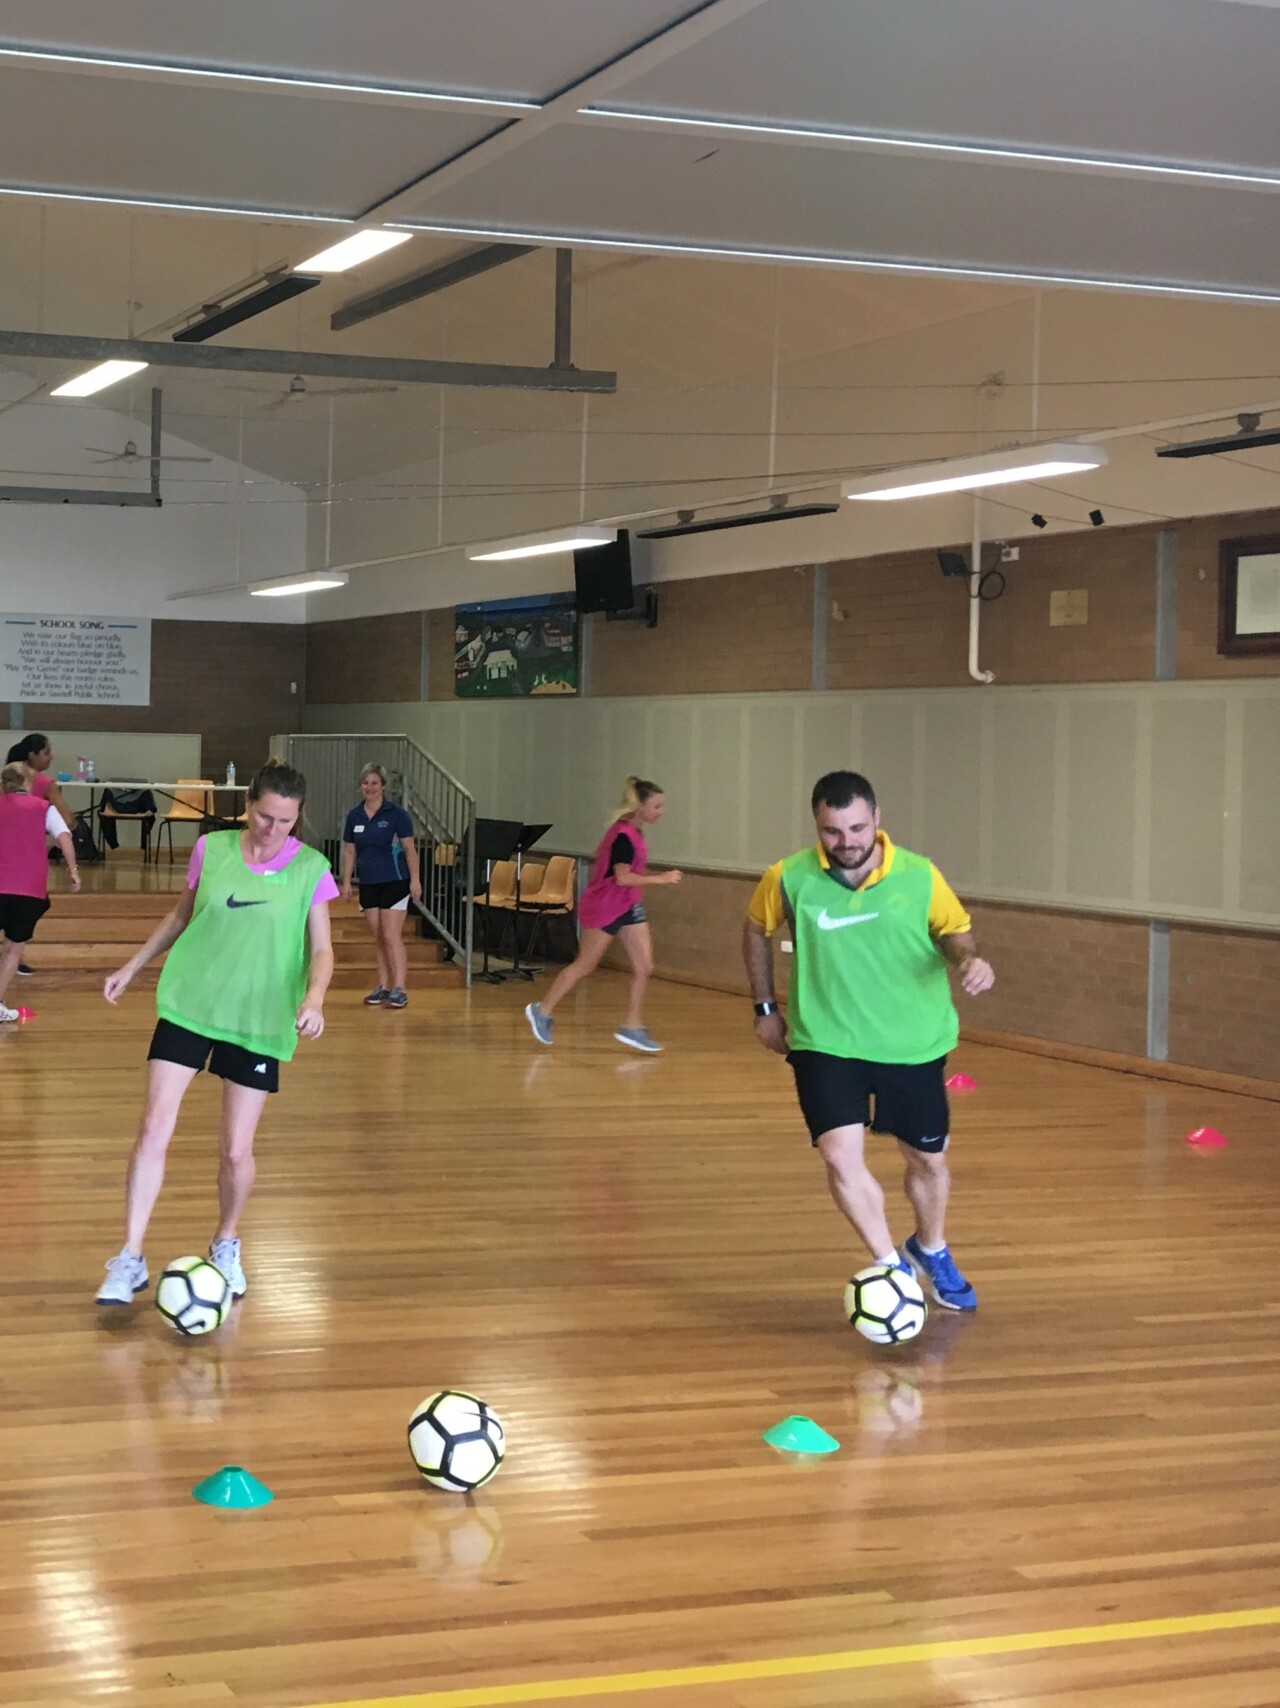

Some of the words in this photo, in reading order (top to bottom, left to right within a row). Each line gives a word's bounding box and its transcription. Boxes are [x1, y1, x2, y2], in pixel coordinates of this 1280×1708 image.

[40, 620, 76, 629] SCHOOL
[79, 621, 105, 630] SONG
[20, 639, 39, 647] With
[77, 640, 93, 649] blue
[95, 642, 105, 650] on
[17, 647, 33, 656] And
[39, 656, 51, 664] will
[52, 657, 75, 665] always
[77, 658, 102, 666] honour
[22, 664, 35, 672] the
[26, 672, 41, 681] Our
[21, 681, 31, 689] Let
